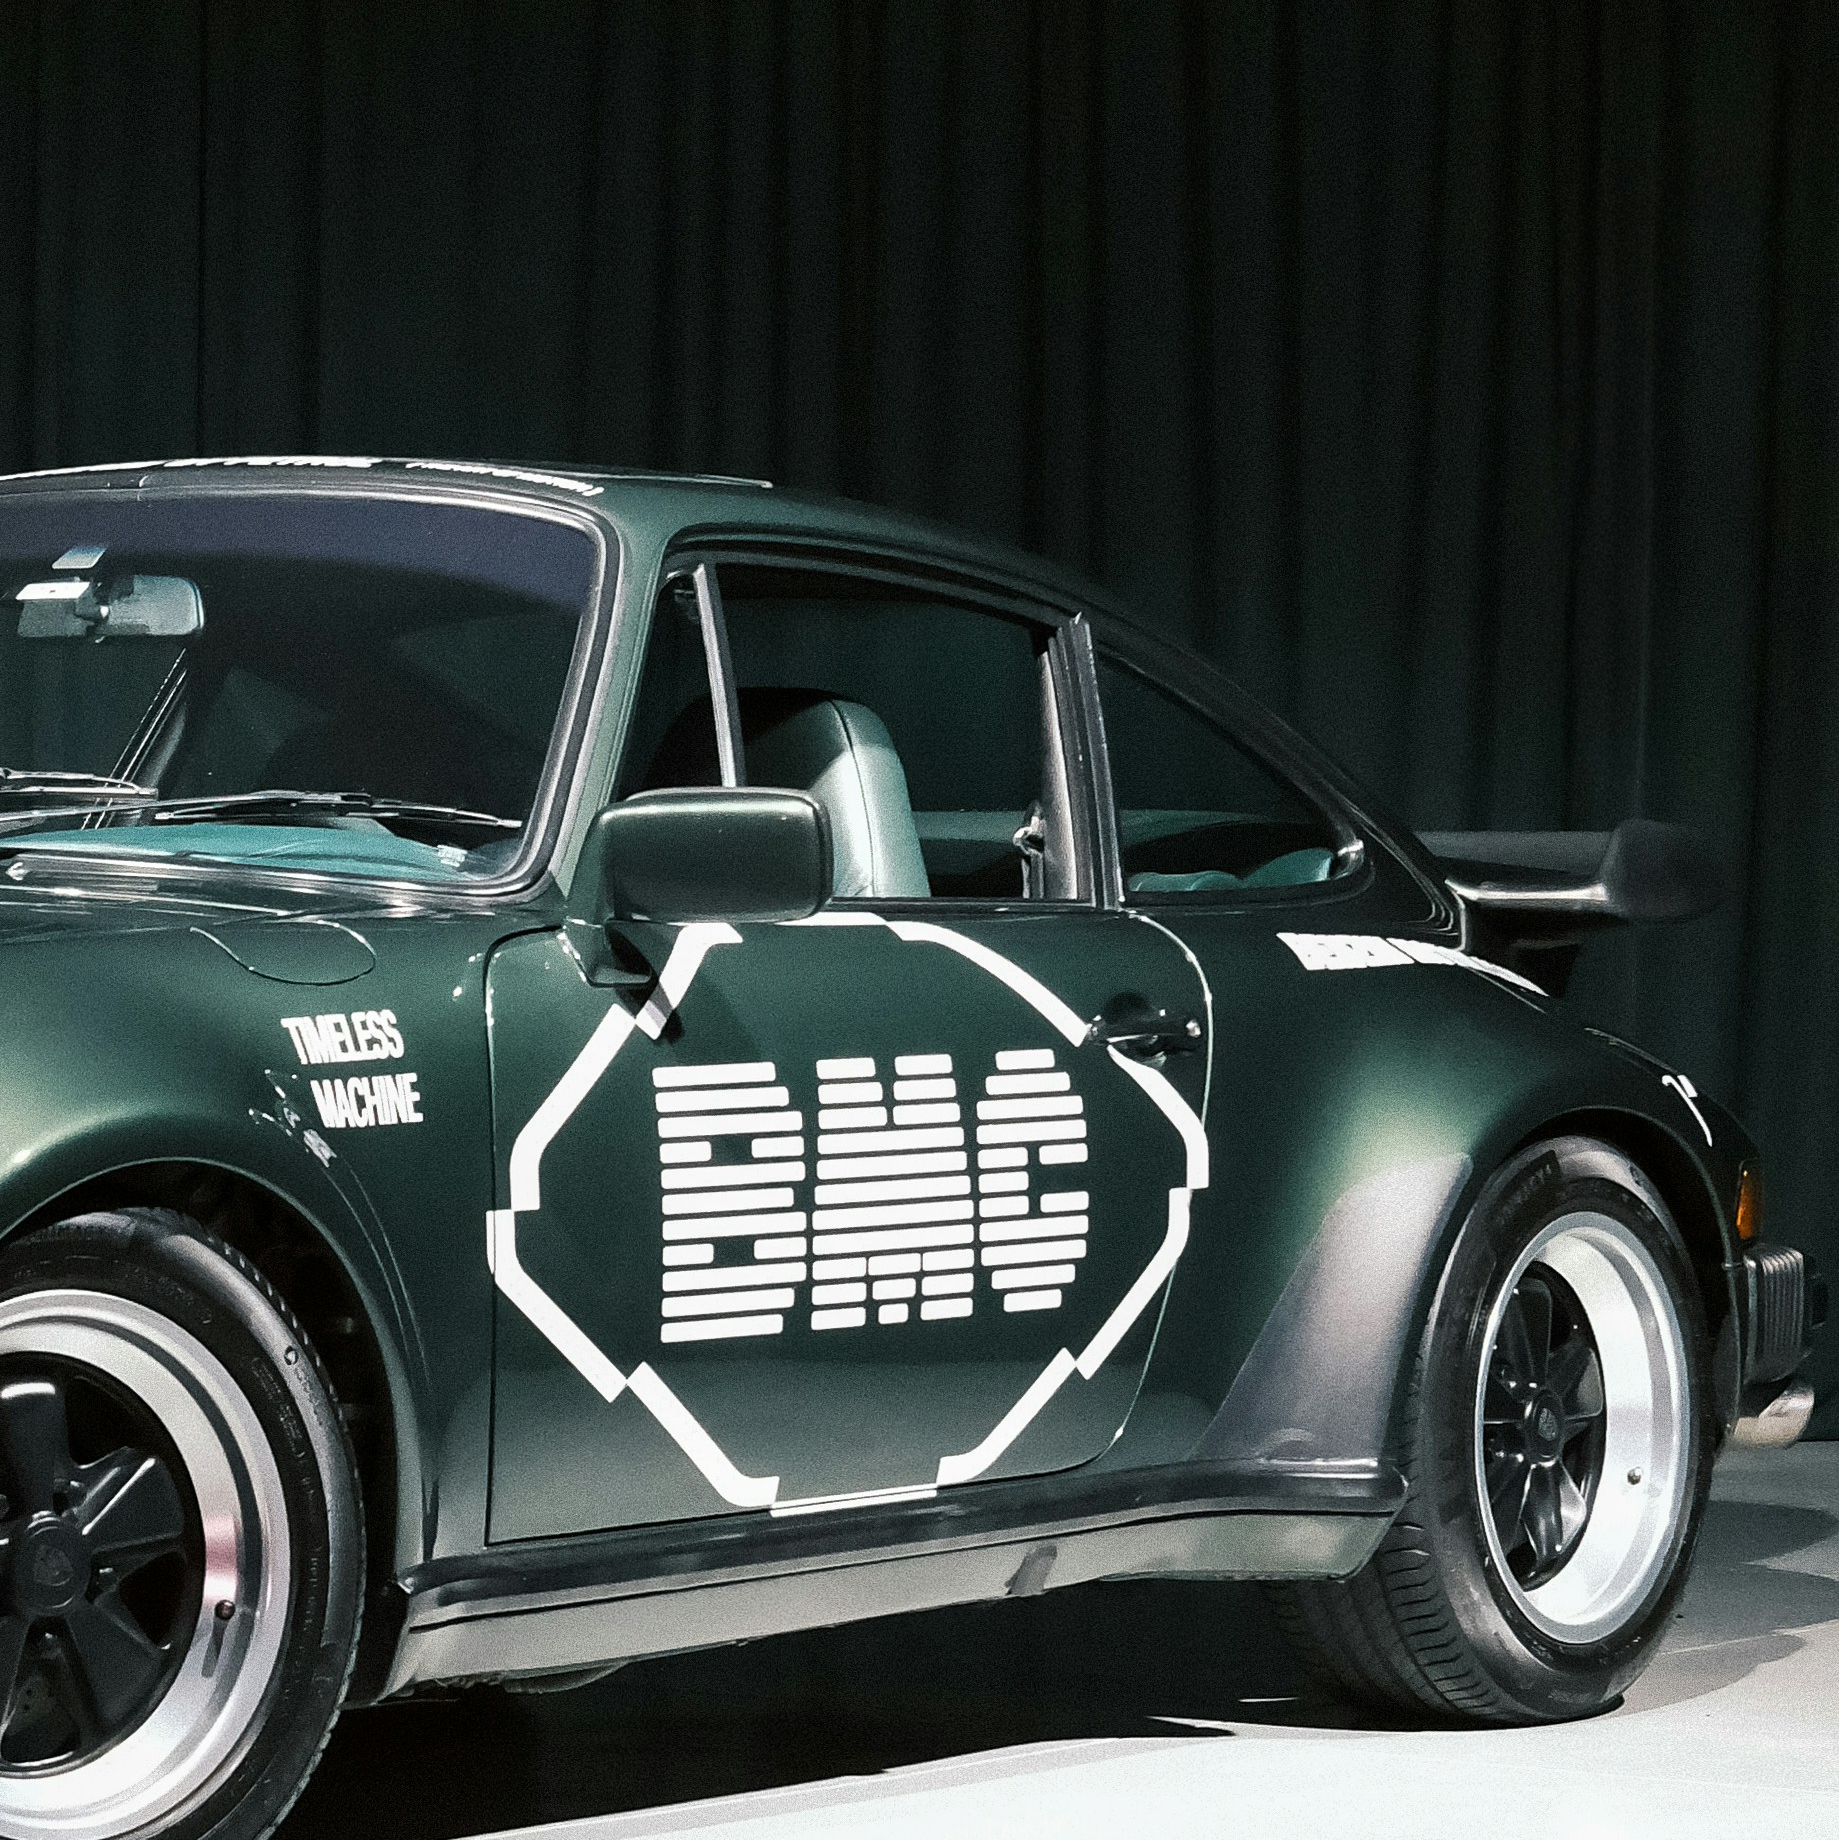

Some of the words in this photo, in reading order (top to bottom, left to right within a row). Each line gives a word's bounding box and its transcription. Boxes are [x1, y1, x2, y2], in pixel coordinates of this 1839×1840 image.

[280, 1009, 405, 1065] TIMELESS
[310, 1072, 424, 1129] MACHINE
[652, 1048, 1088, 1344] BMC
